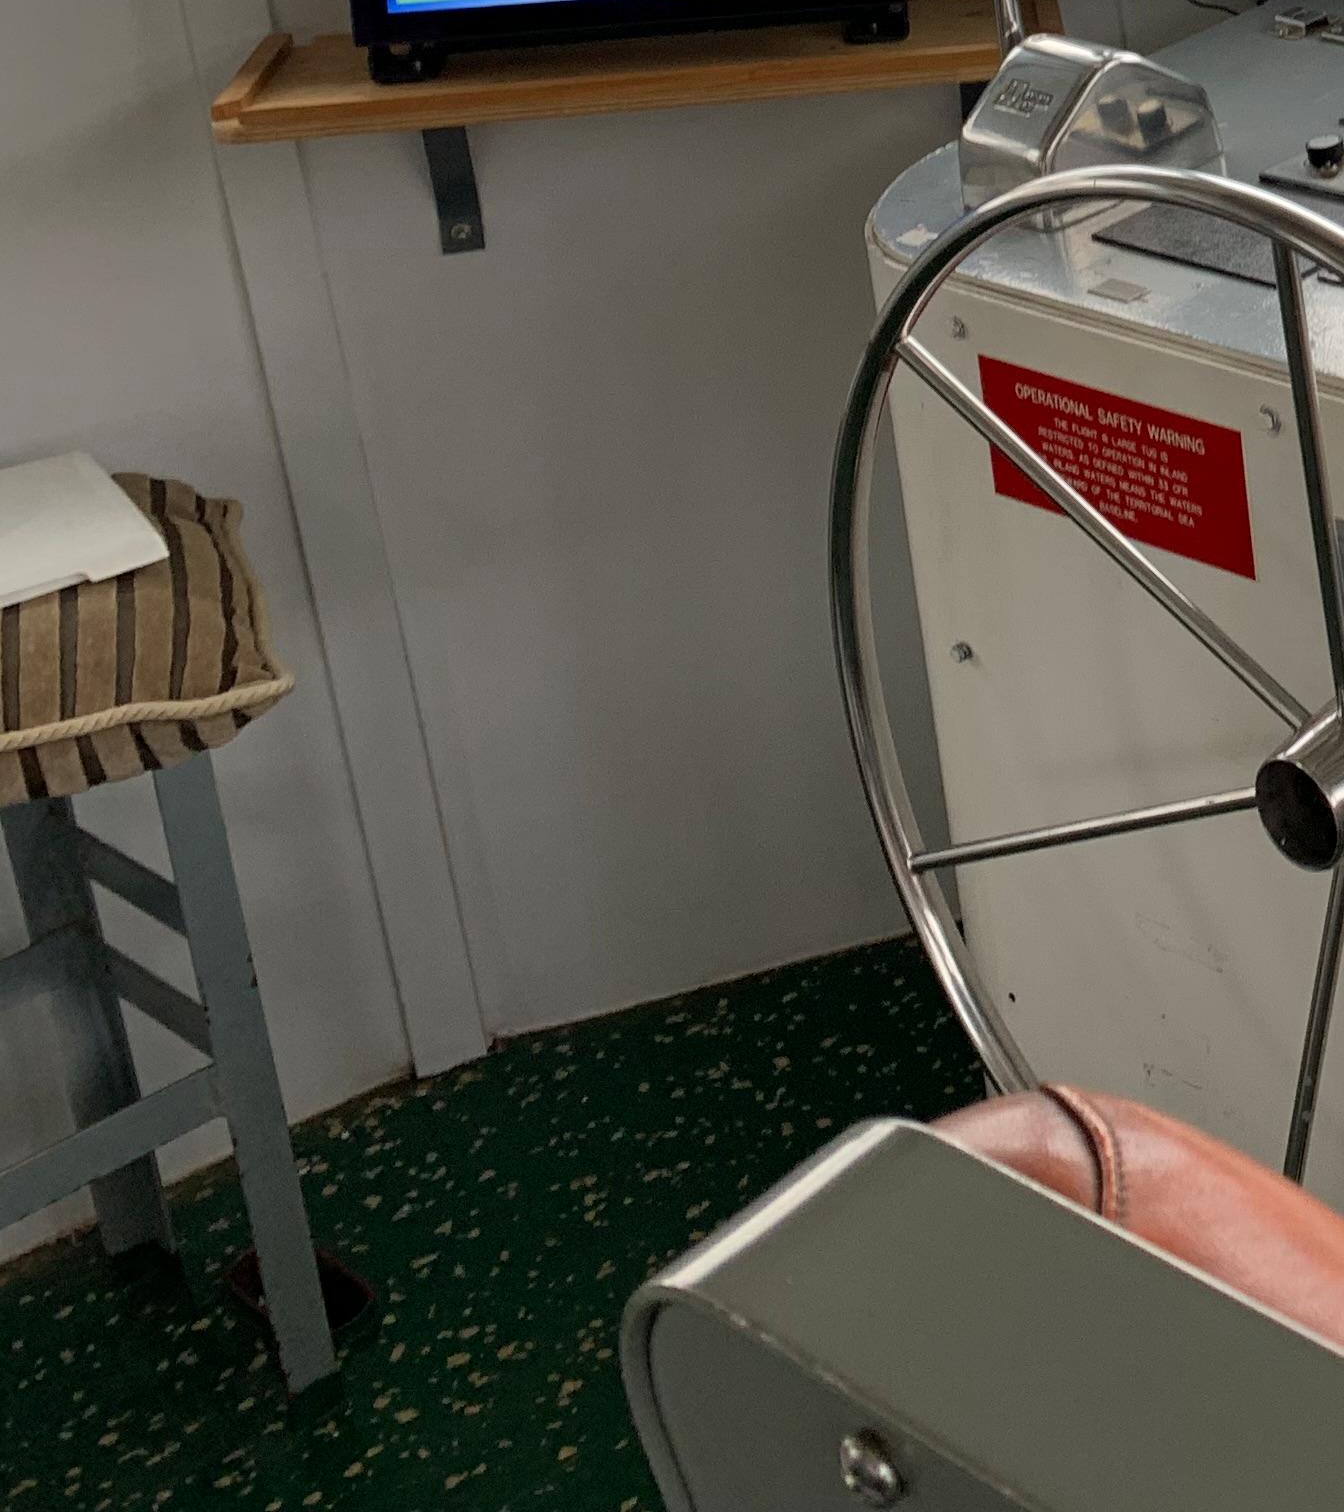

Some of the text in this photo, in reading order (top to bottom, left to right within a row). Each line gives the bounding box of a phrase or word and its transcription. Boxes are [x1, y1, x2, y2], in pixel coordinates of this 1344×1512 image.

[1014, 381, 1206, 457] OPERATIONAL SAFETY WARNING
[1087, 440, 1099, 456] TO
[1100, 444, 1145, 470] OPERATION
[1147, 459, 1157, 474] IN
